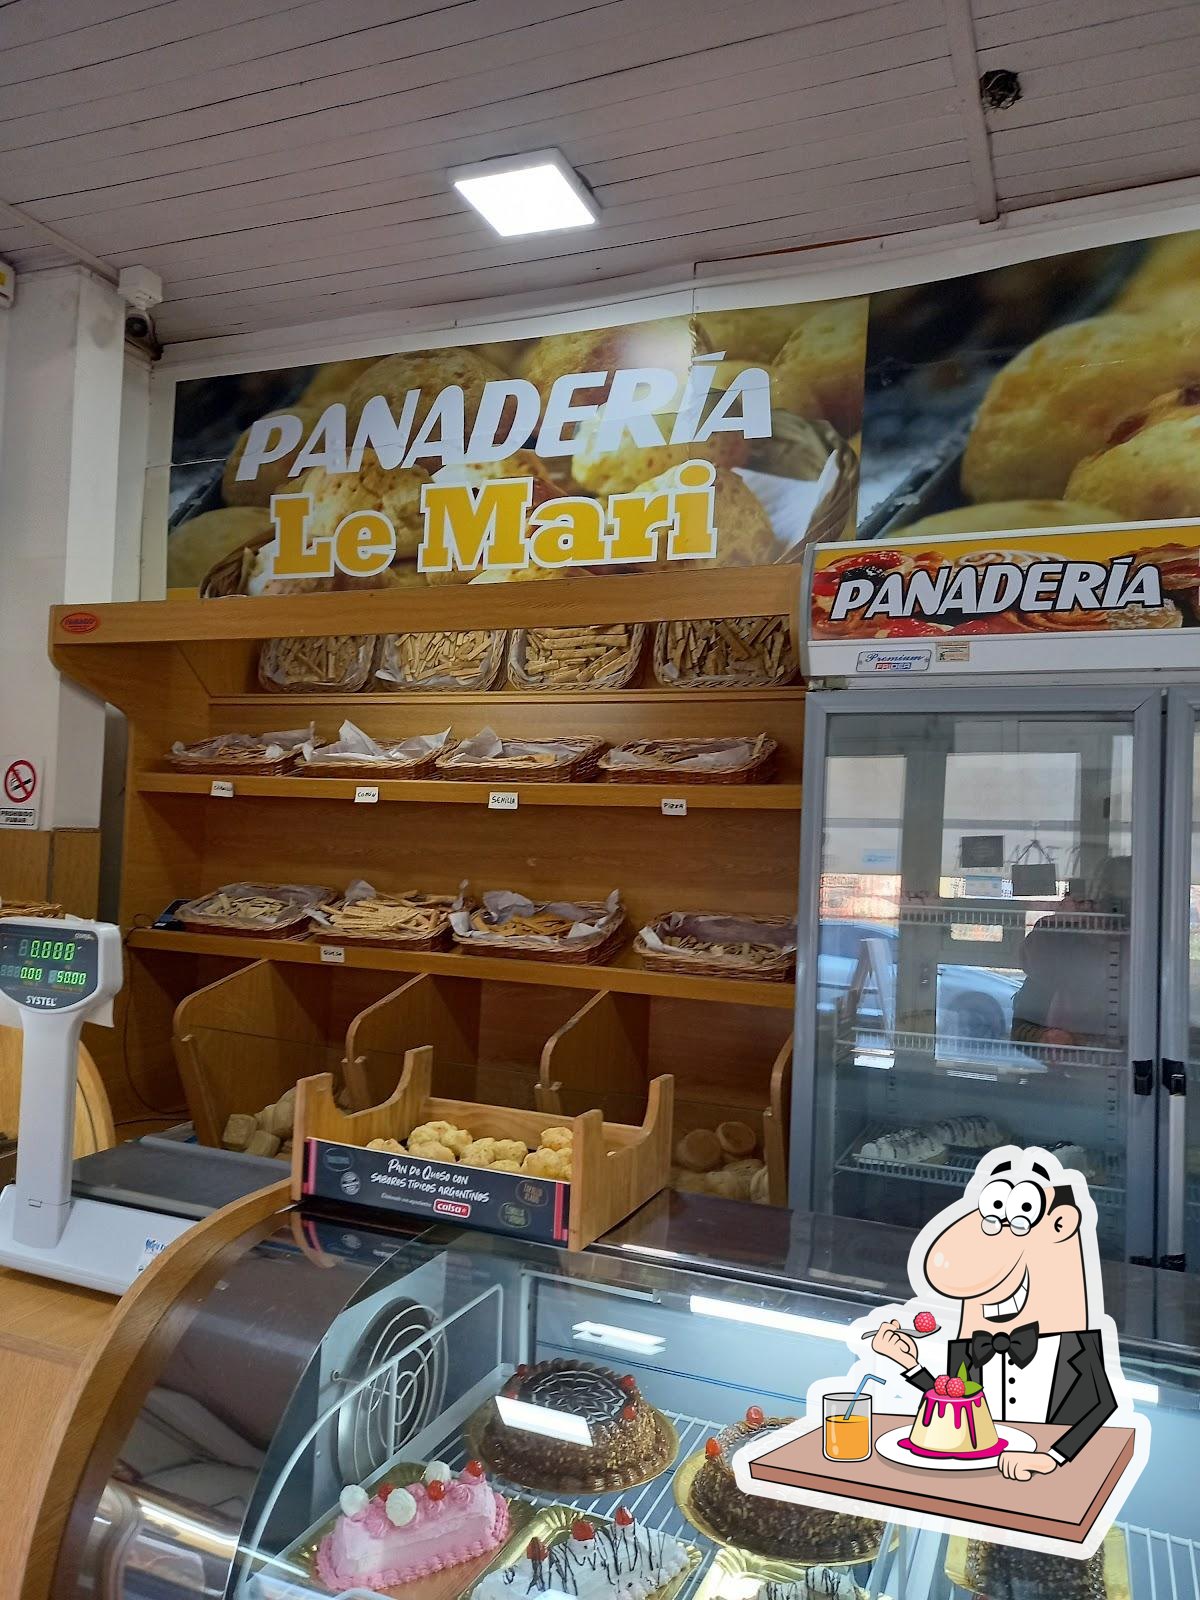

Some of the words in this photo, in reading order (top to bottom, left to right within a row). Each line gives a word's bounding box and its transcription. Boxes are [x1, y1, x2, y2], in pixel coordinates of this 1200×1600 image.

[235, 350, 773, 482] PANADERÍA
[270, 491, 398, 580] Le
[416, 458, 719, 573] Mari
[829, 554, 1164, 622] PANADERÍA
[865, 653, 925, 662] Premium
[25, 995, 57, 1006] SYSTEL
[436, 1202, 462, 1214] calsa
